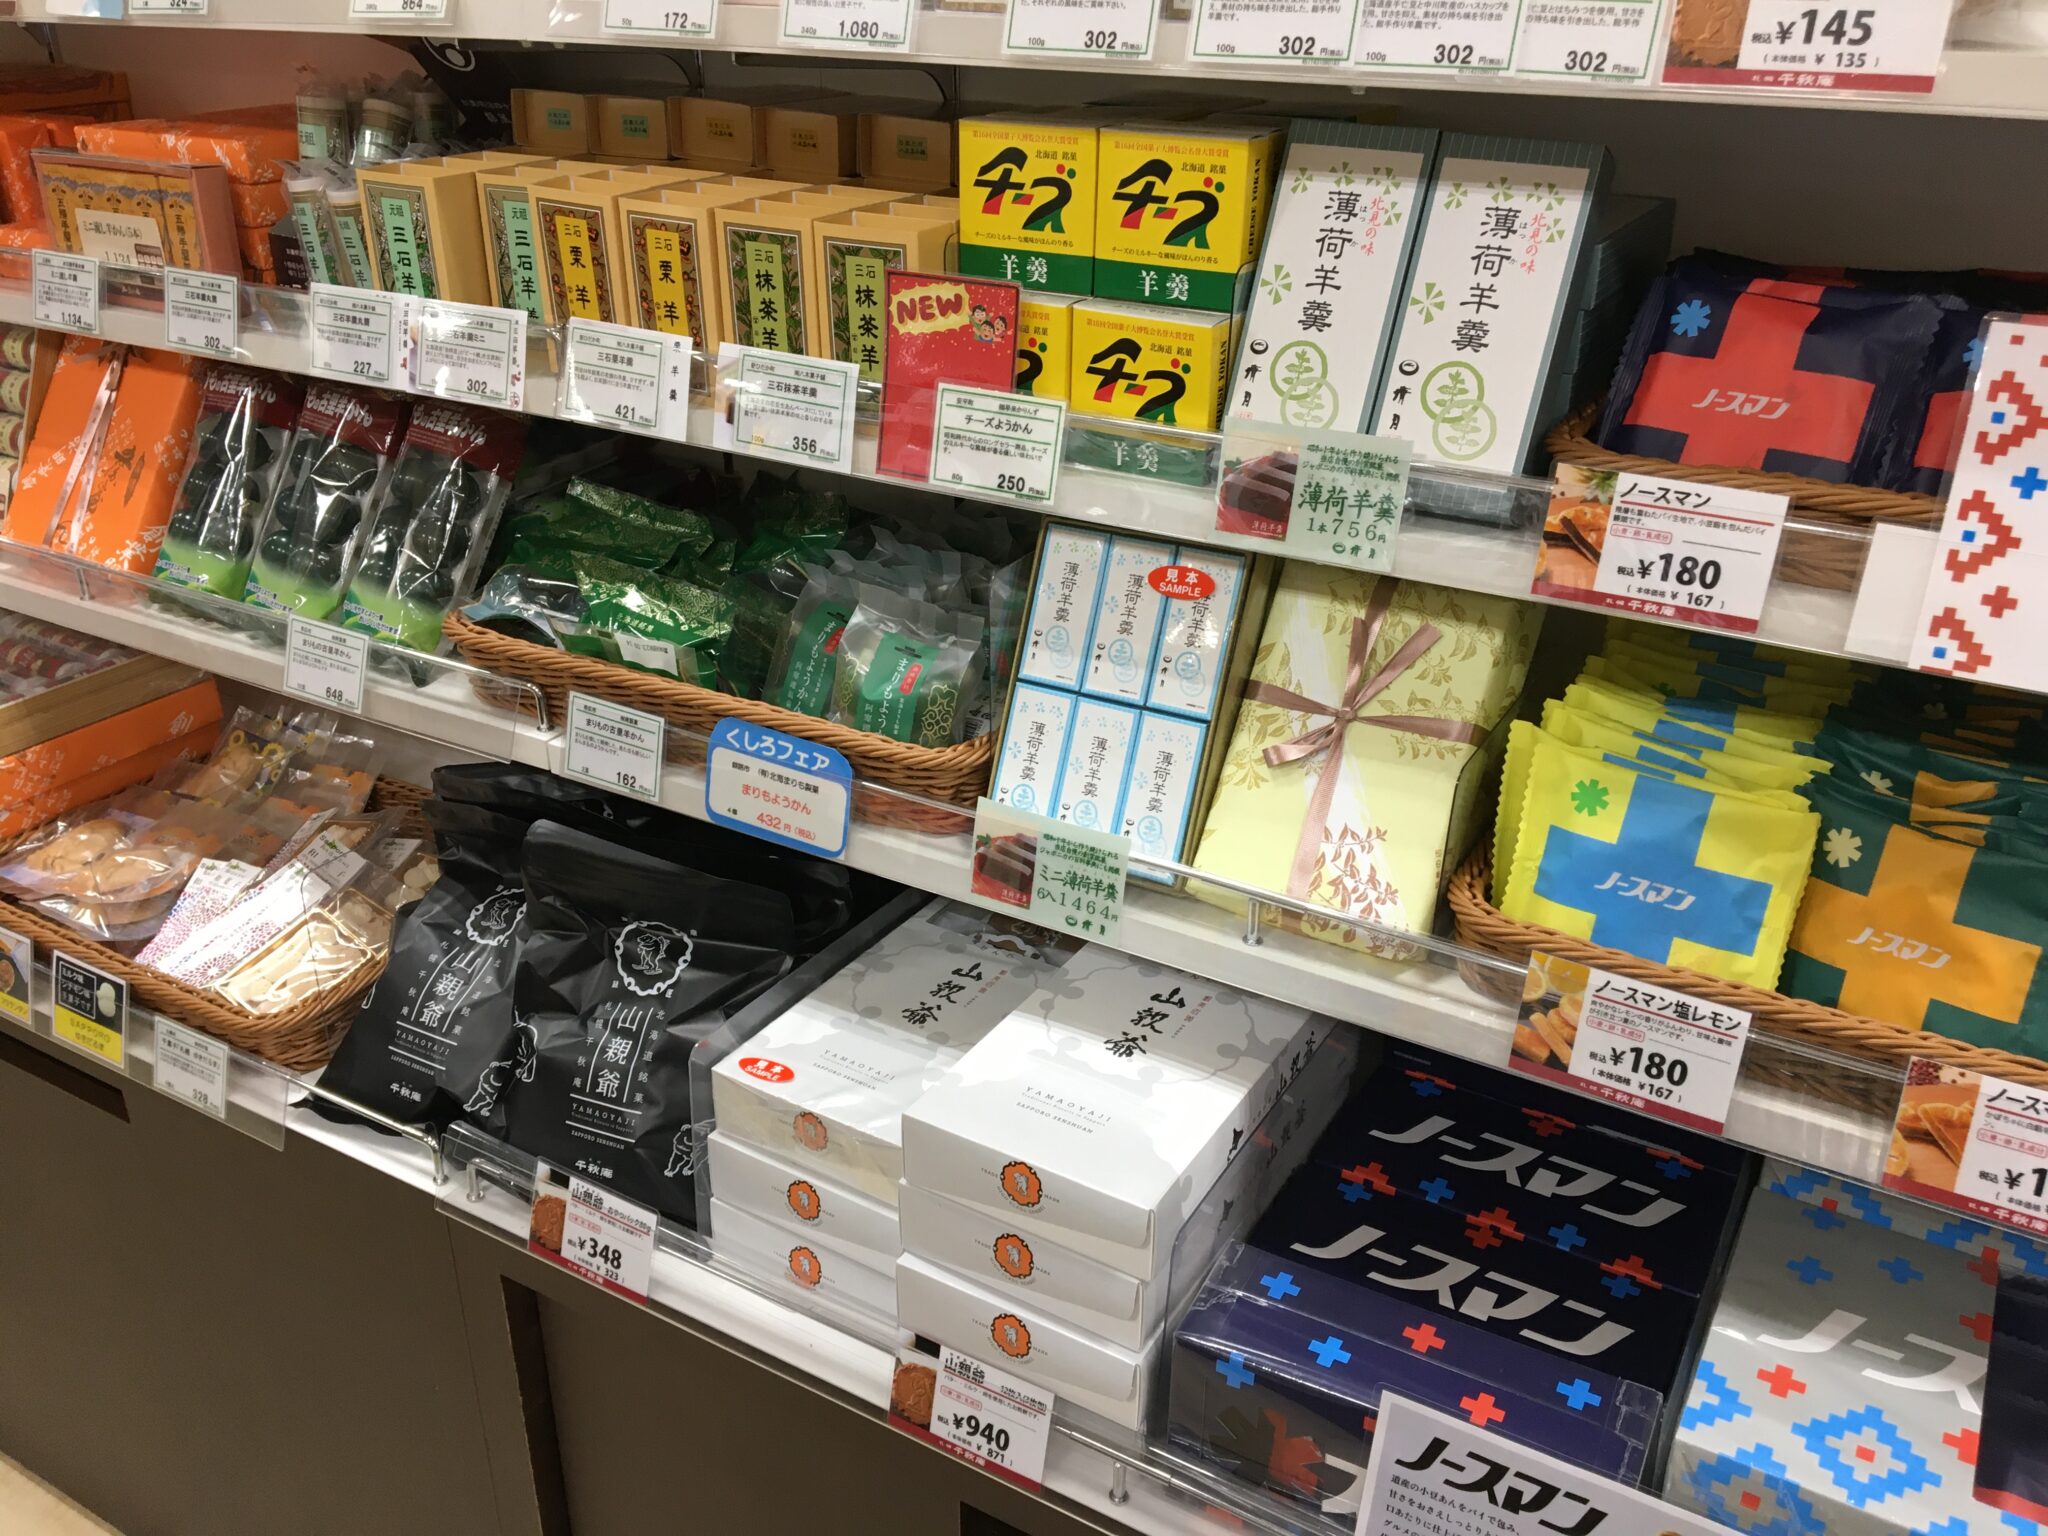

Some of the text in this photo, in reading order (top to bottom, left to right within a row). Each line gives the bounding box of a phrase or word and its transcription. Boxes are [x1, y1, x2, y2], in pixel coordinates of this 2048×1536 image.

[665, 13, 687, 29] 172
[838, 20, 879, 39] 1,080
[1027, 37, 1045, 47] 100g
[1084, 30, 1116, 50] 302
[1215, 43, 1236, 54] 100g
[1278, 36, 1316, 56] 302
[1364, 51, 1387, 62] 100g
[1433, 44, 1475, 65] 302
[1563, 50, 1607, 72] 302
[1034, 148, 1077, 162] 北海道 銘菓
[1181, 161, 1227, 175] 北海道 銘菓
[512, 206, 528, 220] 元祖
[1247, 158, 1262, 257] CHEESE YOKAN
[564, 222, 581, 239] 三石
[655, 236, 673, 252] 三石
[754, 249, 773, 264] 三石
[1297, 190, 1361, 339] 薄荷羊羹
[855, 264, 876, 278] 三石
[999, 252, 1048, 284] 羊羹
[1136, 270, 1190, 301] 羊羹
[1451, 206, 1522, 353] 薄荷羊羹
[61, 311, 82, 326] 1,134
[896, 293, 963, 324] NEW
[203, 335, 221, 349] 302
[1149, 342, 1193, 357] 北海道 銘菓
[353, 359, 372, 374] 227
[466, 378, 488, 394] 302
[768, 380, 818, 399] 三石抹茶羊羹
[615, 404, 636, 421] 421
[966, 415, 1034, 436] チーズようかん
[793, 437, 818, 455] 356
[998, 475, 1025, 493] 250
[1297, 480, 1398, 526] 薄荷羊羹
[1619, 482, 1712, 509] ノースマン
[1168, 570, 1201, 592] 見本
[1616, 552, 1721, 590] 税込 ¥180
[1160, 582, 1205, 602] SAMPLE
[326, 686, 343, 702] 648
[726, 728, 830, 771] くしろフェア
[617, 771, 636, 789] 162
[741, 782, 812, 816] まりもようかん
[757, 812, 781, 831] 432
[1039, 864, 1119, 906] ミニ薄荷羊羹
[1594, 979, 1743, 1033] ノースマン塩レモン
[596, 1005, 643, 1099] 山親爺
[743, 1062, 781, 1084] SAMPLE
[754, 1057, 784, 1073] 見本
[823, 1047, 896, 1082] YAMAOYAJI
[1588, 1046, 1689, 1088] 税込 ¥180
[572, 1102, 636, 1127] YAMAOYAJI
[1024, 1085, 1113, 1123] YAMAOYAJI
[575, 1159, 614, 1179] 千秋庵
[1367, 1114, 1688, 1228] ノースマン
[577, 1236, 622, 1271] ¥348
[1289, 1224, 1637, 1357] ノースマン
[952, 1412, 1010, 1452] ¥940
[1393, 1436, 1609, 1536] ノースマン
